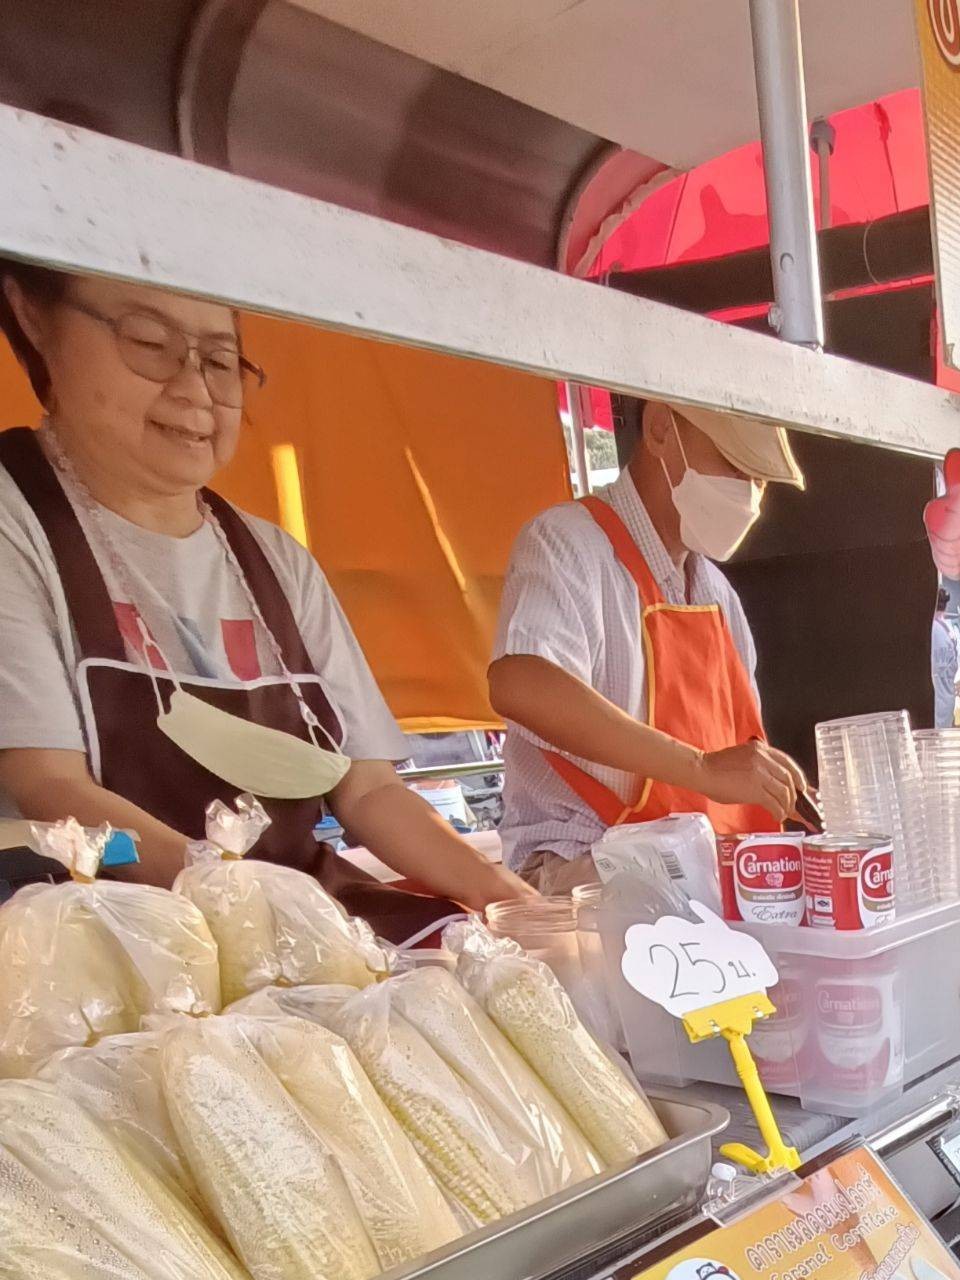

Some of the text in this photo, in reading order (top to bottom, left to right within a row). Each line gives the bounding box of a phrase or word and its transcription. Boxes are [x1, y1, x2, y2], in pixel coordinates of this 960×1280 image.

[739, 852, 801, 879] Carnation
[751, 904, 798, 921] Extra
[649, 942, 726, 999] 25
[830, 1205, 899, 1253] Cornflake
